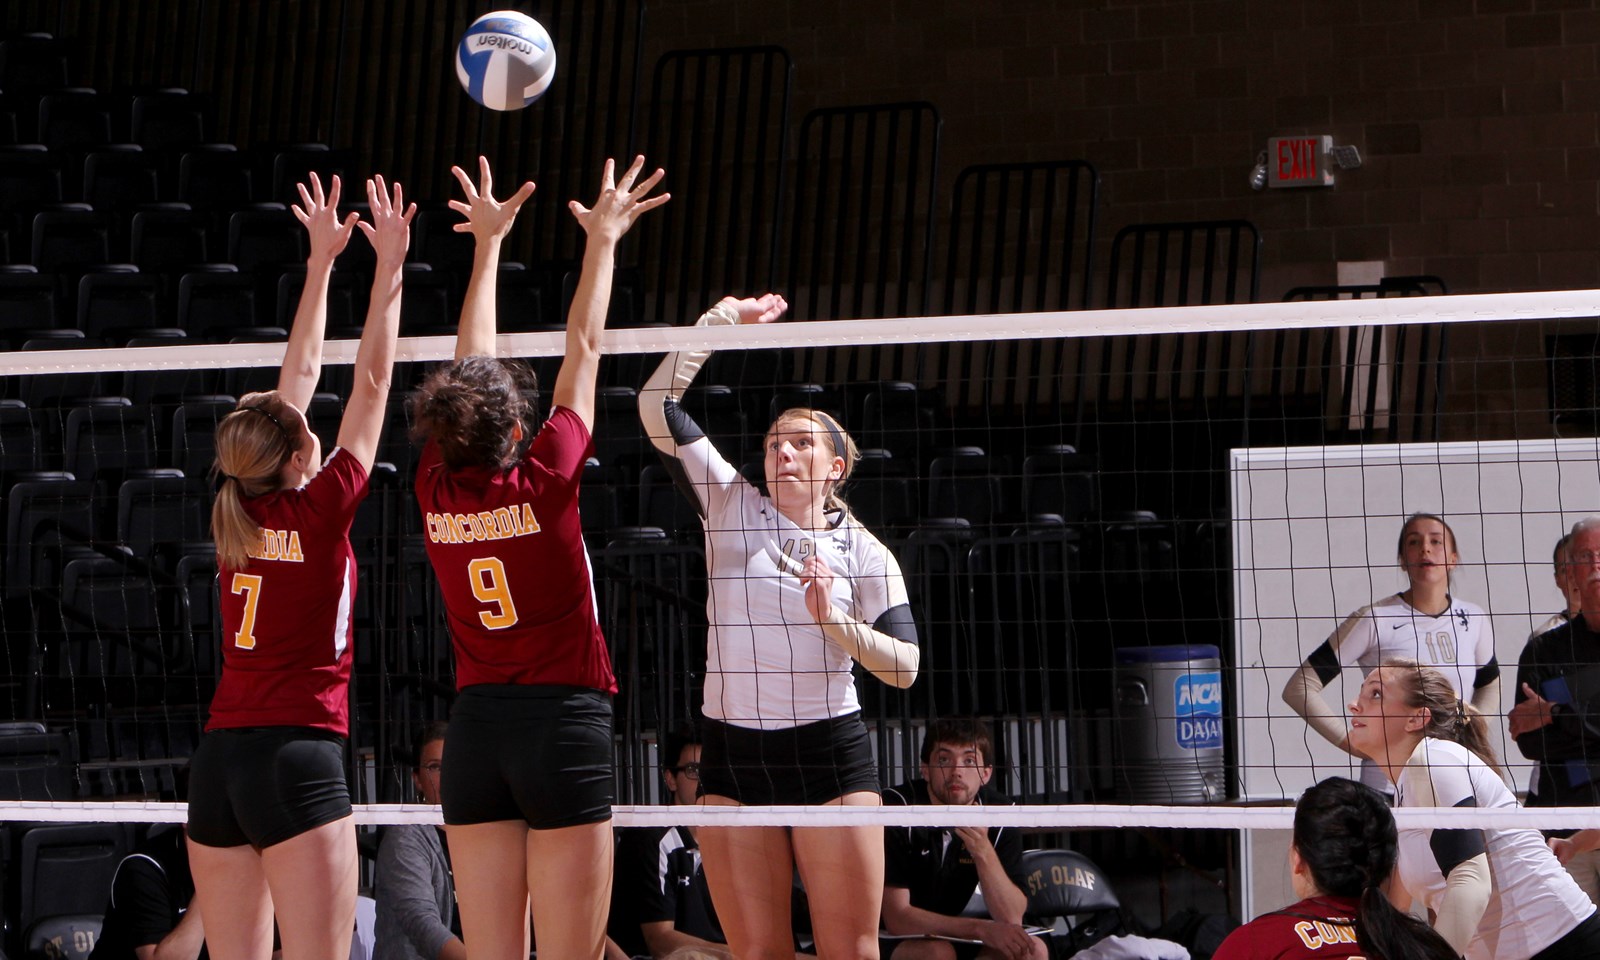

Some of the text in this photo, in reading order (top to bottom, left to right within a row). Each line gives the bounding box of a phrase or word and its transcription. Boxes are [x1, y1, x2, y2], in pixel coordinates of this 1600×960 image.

[478, 35, 533, 55] molten
[1277, 138, 1317, 180] EXIT
[426, 502, 541, 544] CONCORDIA
[231, 572, 263, 650] 7
[467, 556, 519, 630] 9
[1425, 631, 1456, 664] 10
[1027, 865, 1096, 896] ST. OLAF
